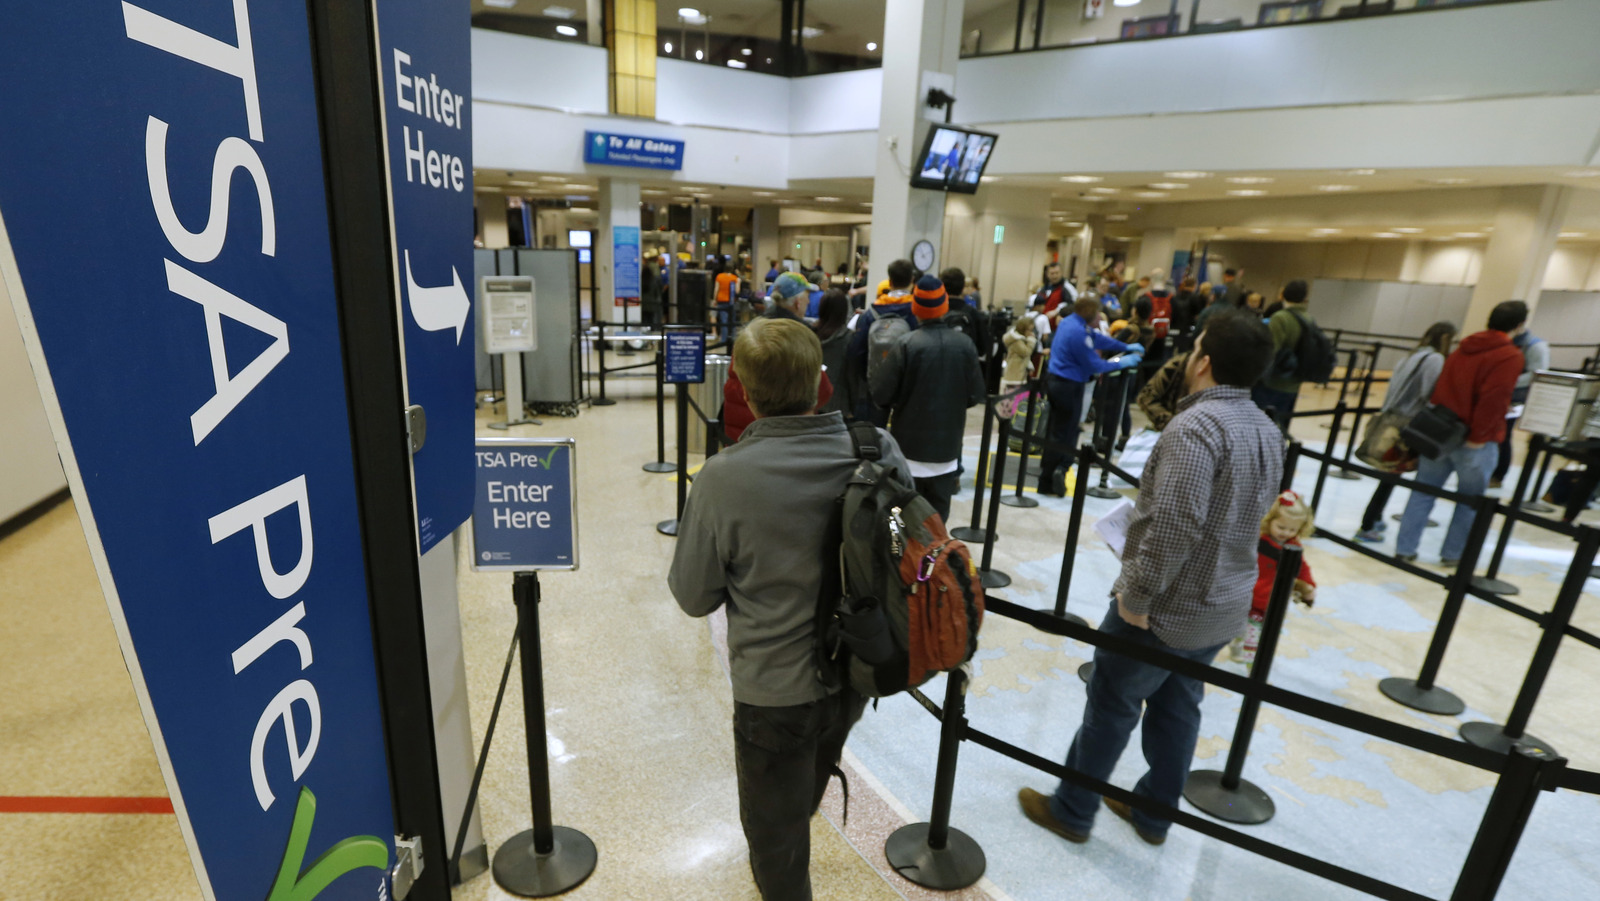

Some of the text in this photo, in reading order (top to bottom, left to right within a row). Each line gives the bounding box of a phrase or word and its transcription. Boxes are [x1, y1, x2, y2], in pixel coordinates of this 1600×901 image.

[393, 48, 464, 130] Enter
[608, 136, 677, 154] To All Gates
[403, 125, 465, 193] Here
[121, 0, 322, 812] TSA Pre
[475, 452, 538, 468] TSA Pre
[487, 481, 553, 503] Enter
[493, 507, 551, 529] Here
